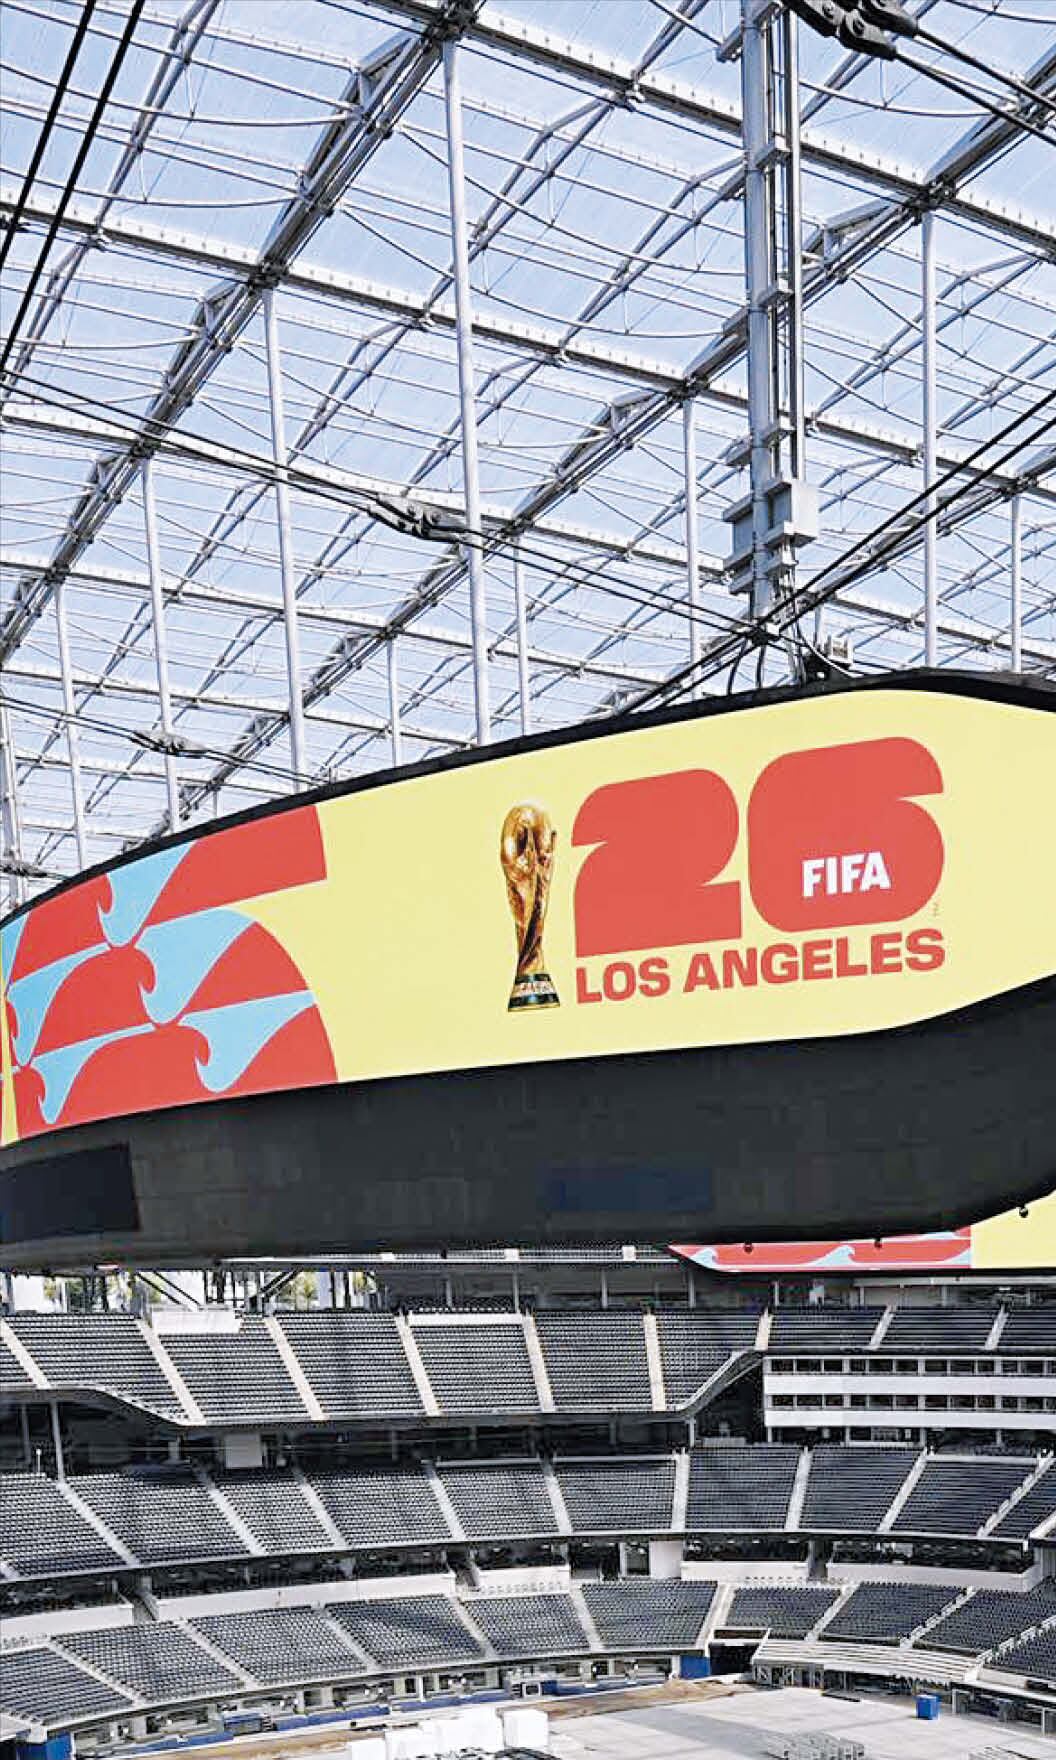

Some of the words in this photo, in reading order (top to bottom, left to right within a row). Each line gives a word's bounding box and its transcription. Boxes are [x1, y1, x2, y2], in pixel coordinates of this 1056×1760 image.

[571, 737, 945, 957] 26
[802, 852, 891, 898] FIFA
[576, 957, 670, 1004] LOS
[683, 928, 946, 993] ANGELES
